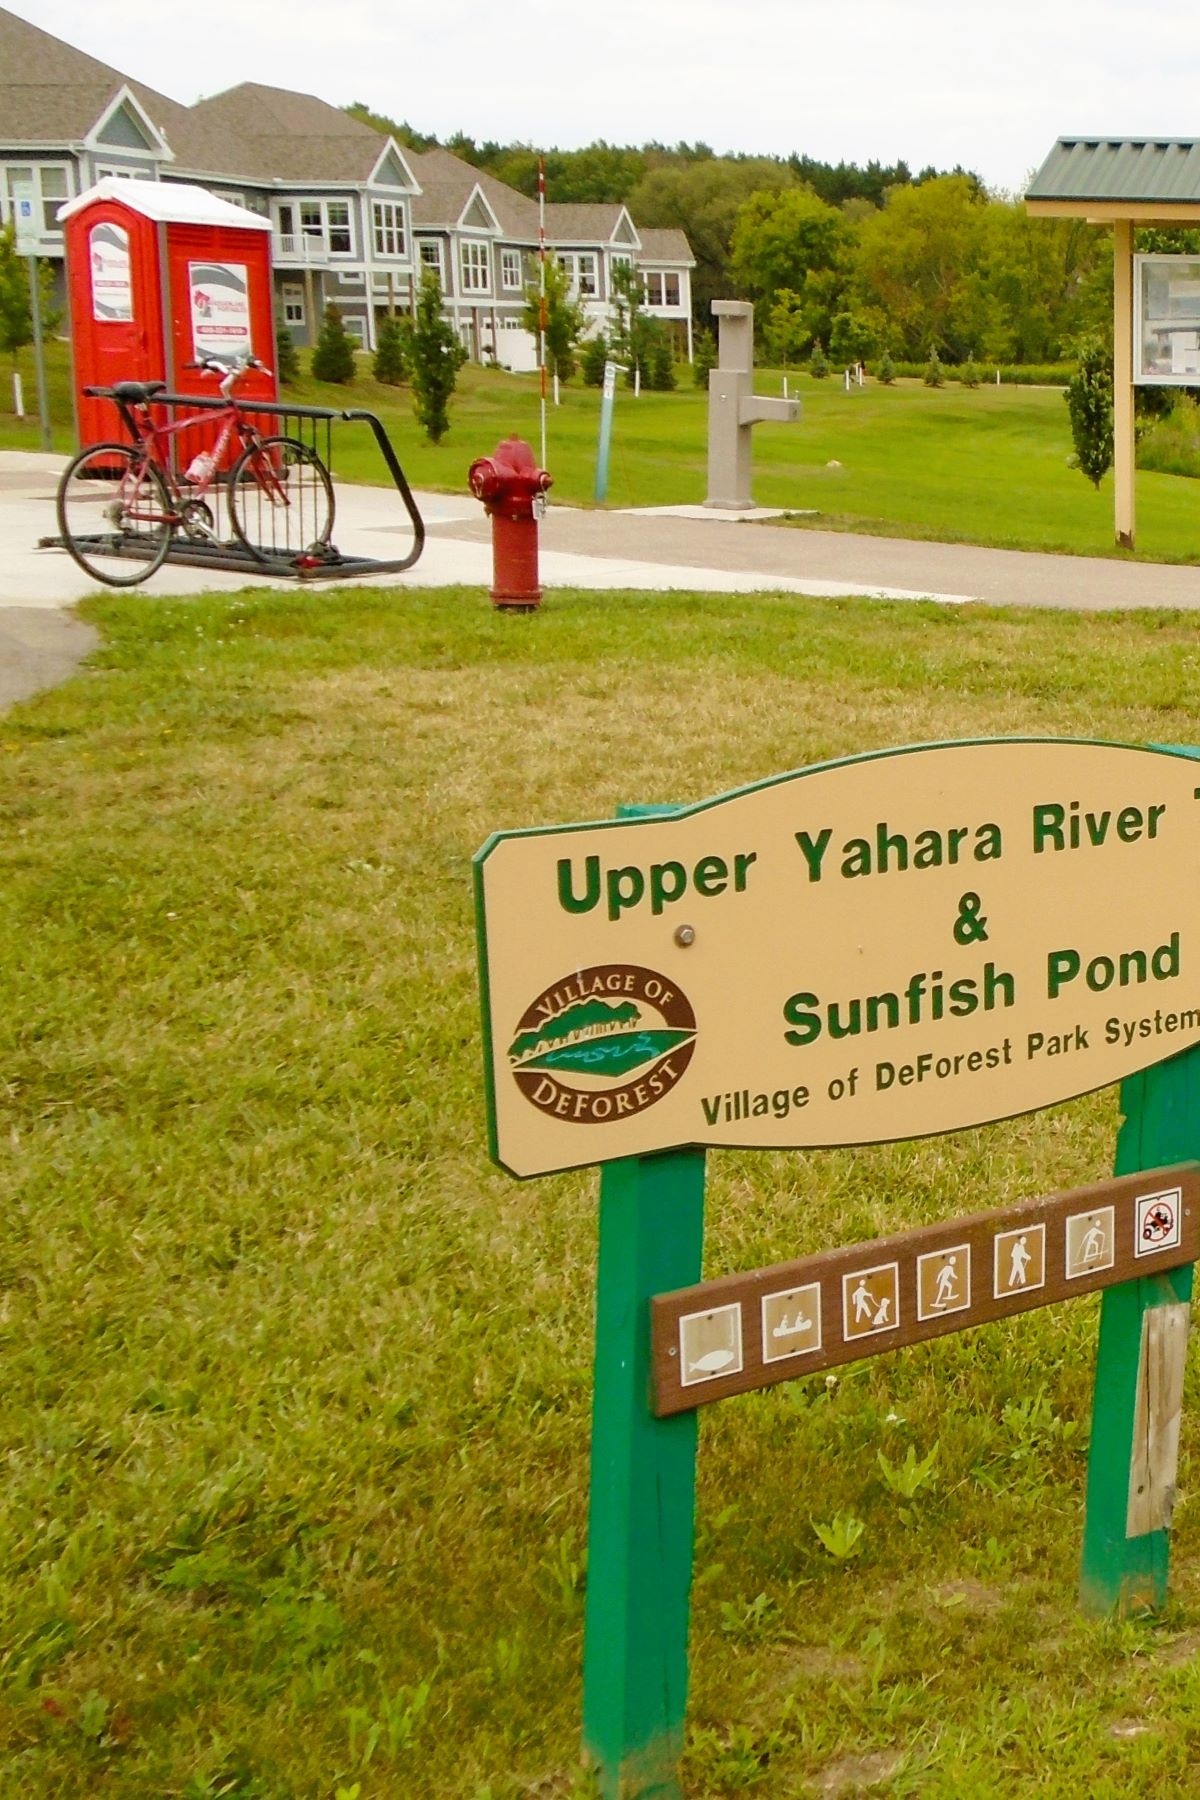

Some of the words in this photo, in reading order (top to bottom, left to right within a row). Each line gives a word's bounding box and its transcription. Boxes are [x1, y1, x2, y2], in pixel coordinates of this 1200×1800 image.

[557, 852, 757, 921] Upper
[795, 823, 1001, 882] Yahara
[1033, 801, 1165, 853] River
[953, 892, 989, 945] &
[536, 975, 634, 1016] VILLAGE
[645, 980, 673, 1006] OF
[783, 962, 1014, 1046] Sunfish
[1048, 932, 1179, 999] Pond
[701, 1086, 810, 1126] Village
[828, 1068, 859, 1100] of
[876, 1039, 1011, 1091] DeForest
[1028, 1025, 1089, 1059] Park
